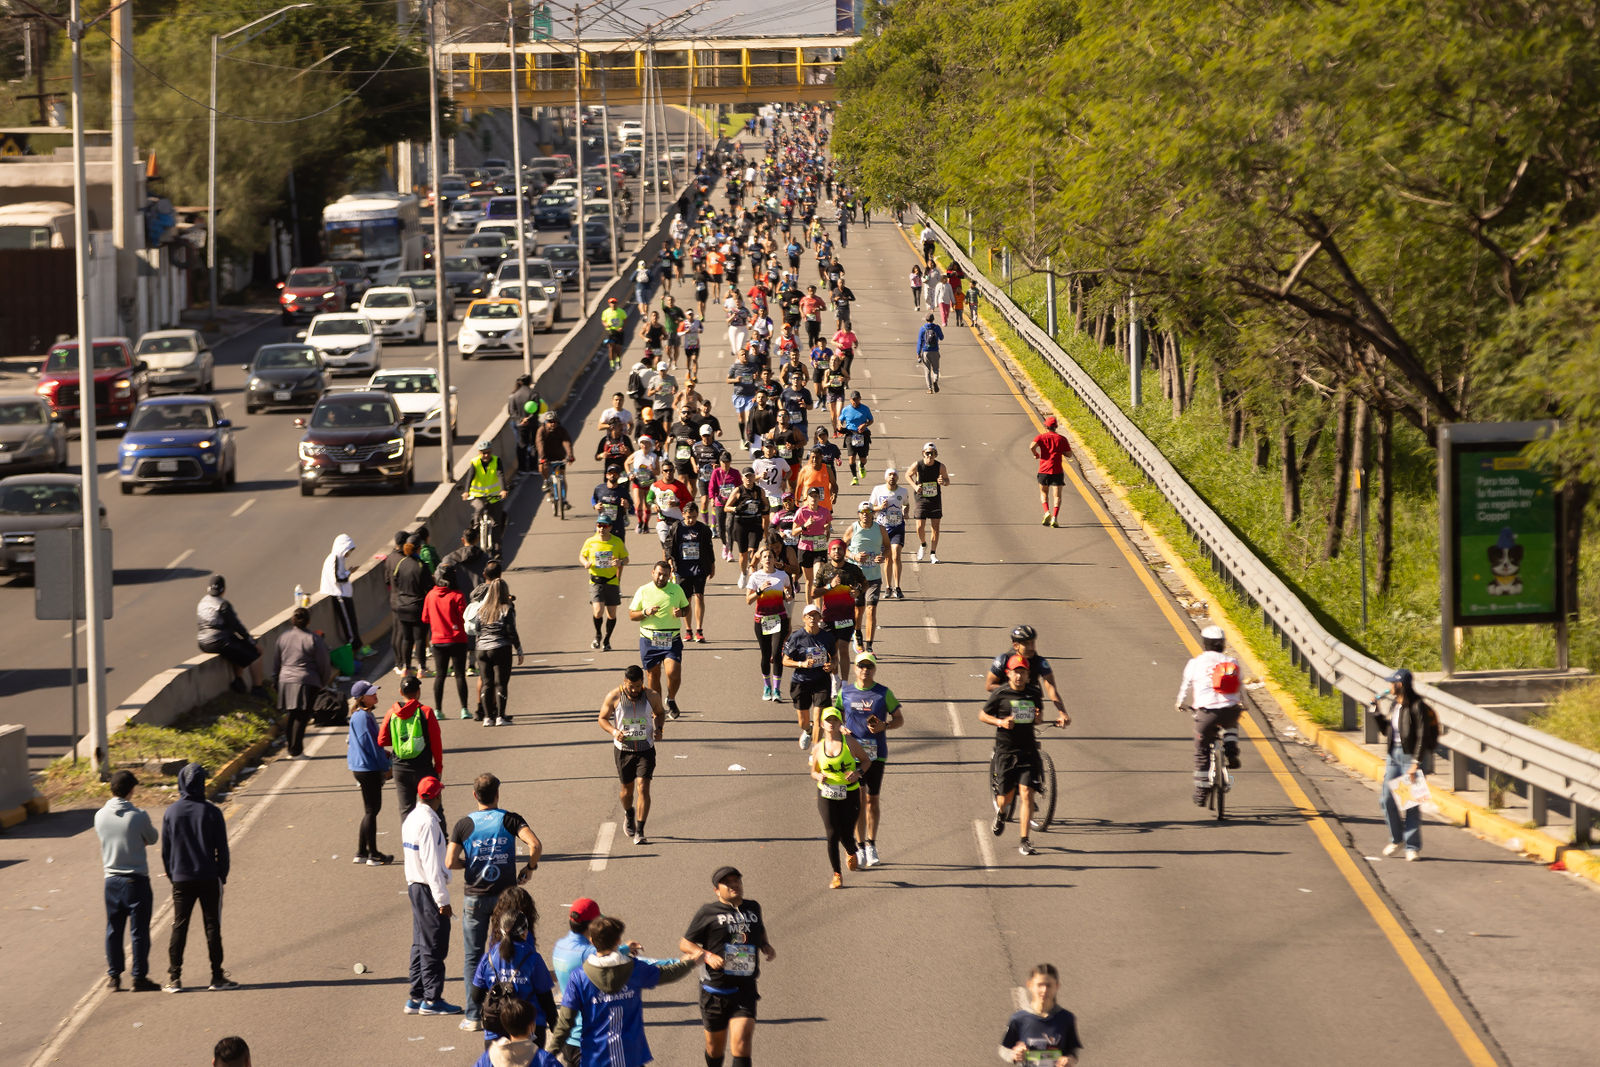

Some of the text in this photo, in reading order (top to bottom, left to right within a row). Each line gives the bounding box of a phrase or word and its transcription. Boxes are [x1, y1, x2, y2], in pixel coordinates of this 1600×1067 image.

[1477, 476, 1496, 486] Para
[1487, 487, 1517, 498] familia
[1519, 487, 1535, 499] hay
[1477, 499, 1531, 511] un regalo en
[732, 962, 749, 971] 290
